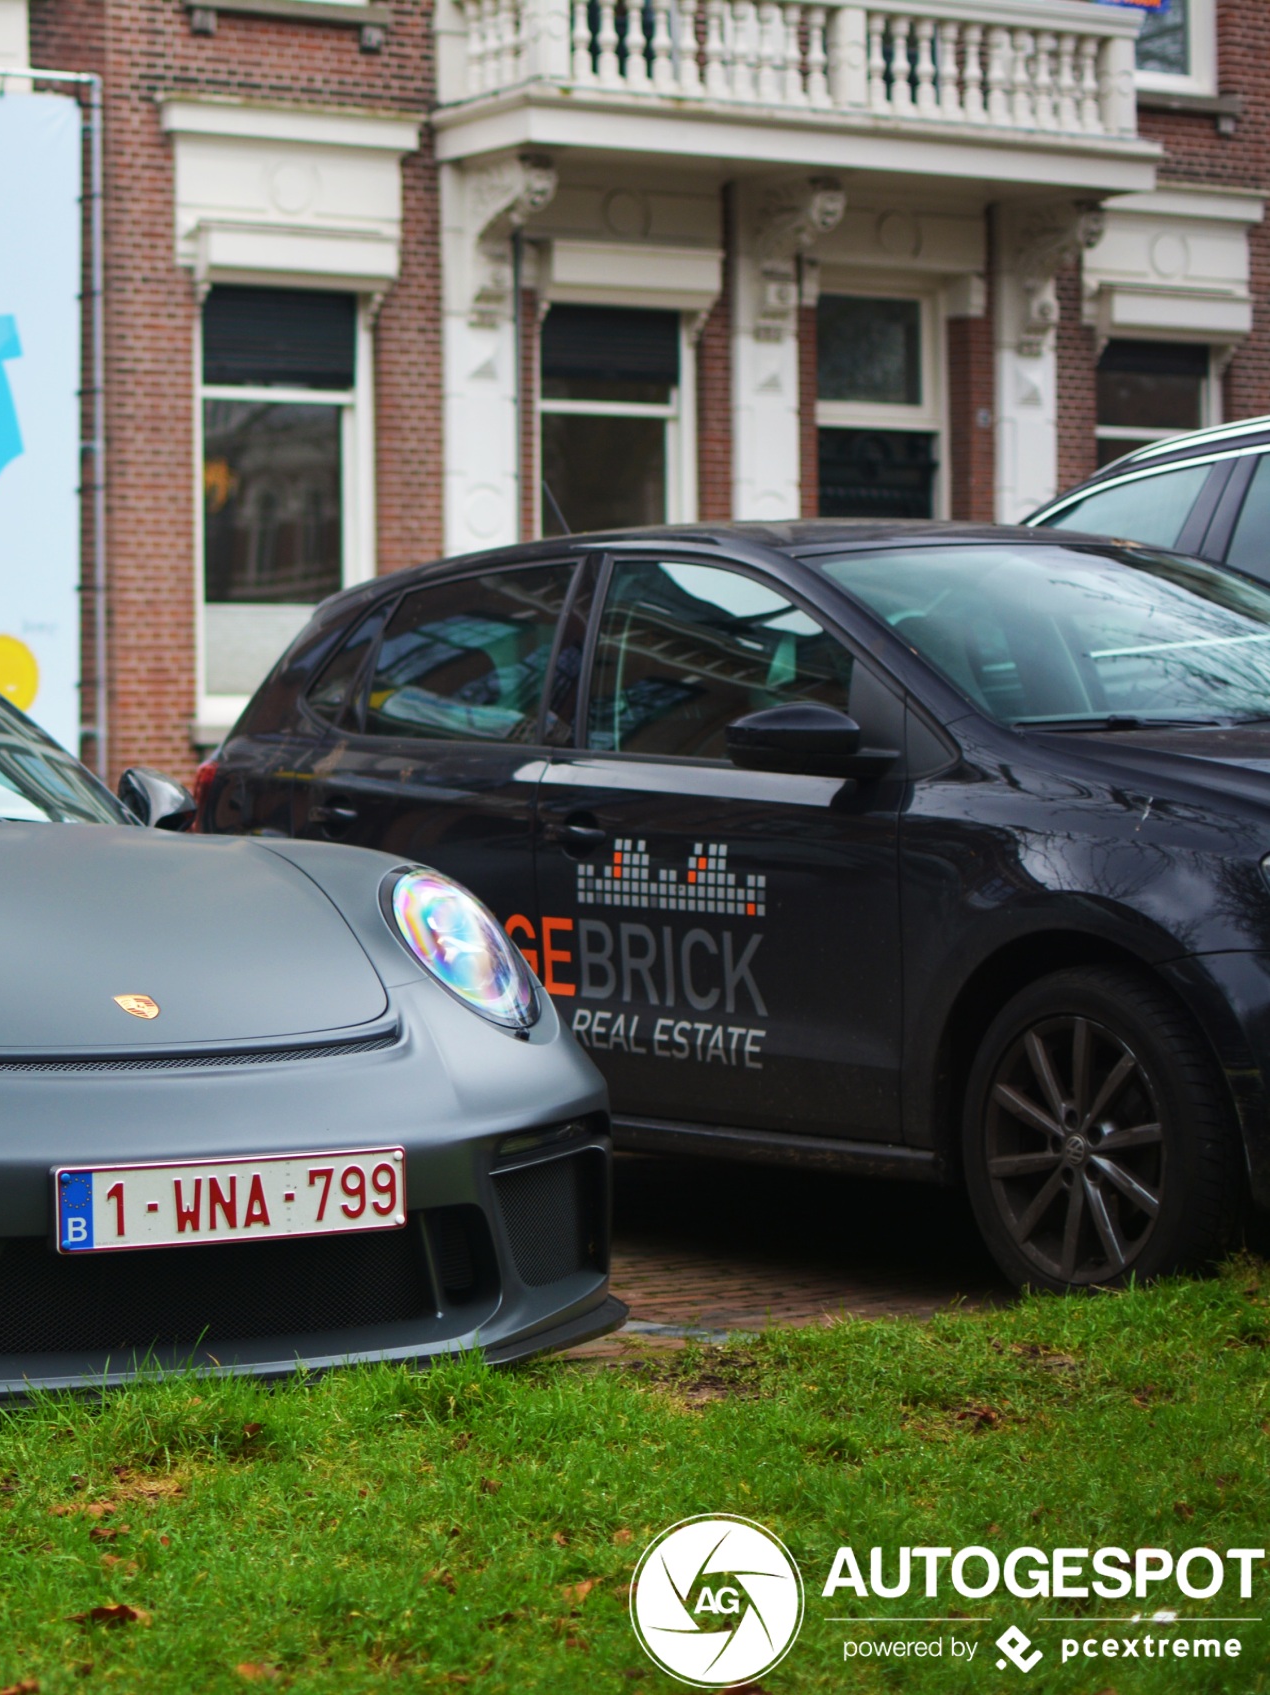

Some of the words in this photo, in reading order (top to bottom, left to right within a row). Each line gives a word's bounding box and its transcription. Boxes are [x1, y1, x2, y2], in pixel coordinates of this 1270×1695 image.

[572, 1008, 647, 1054] REAL
[653, 1018, 767, 1070] ESTATE
[67, 1217, 88, 1243] B
